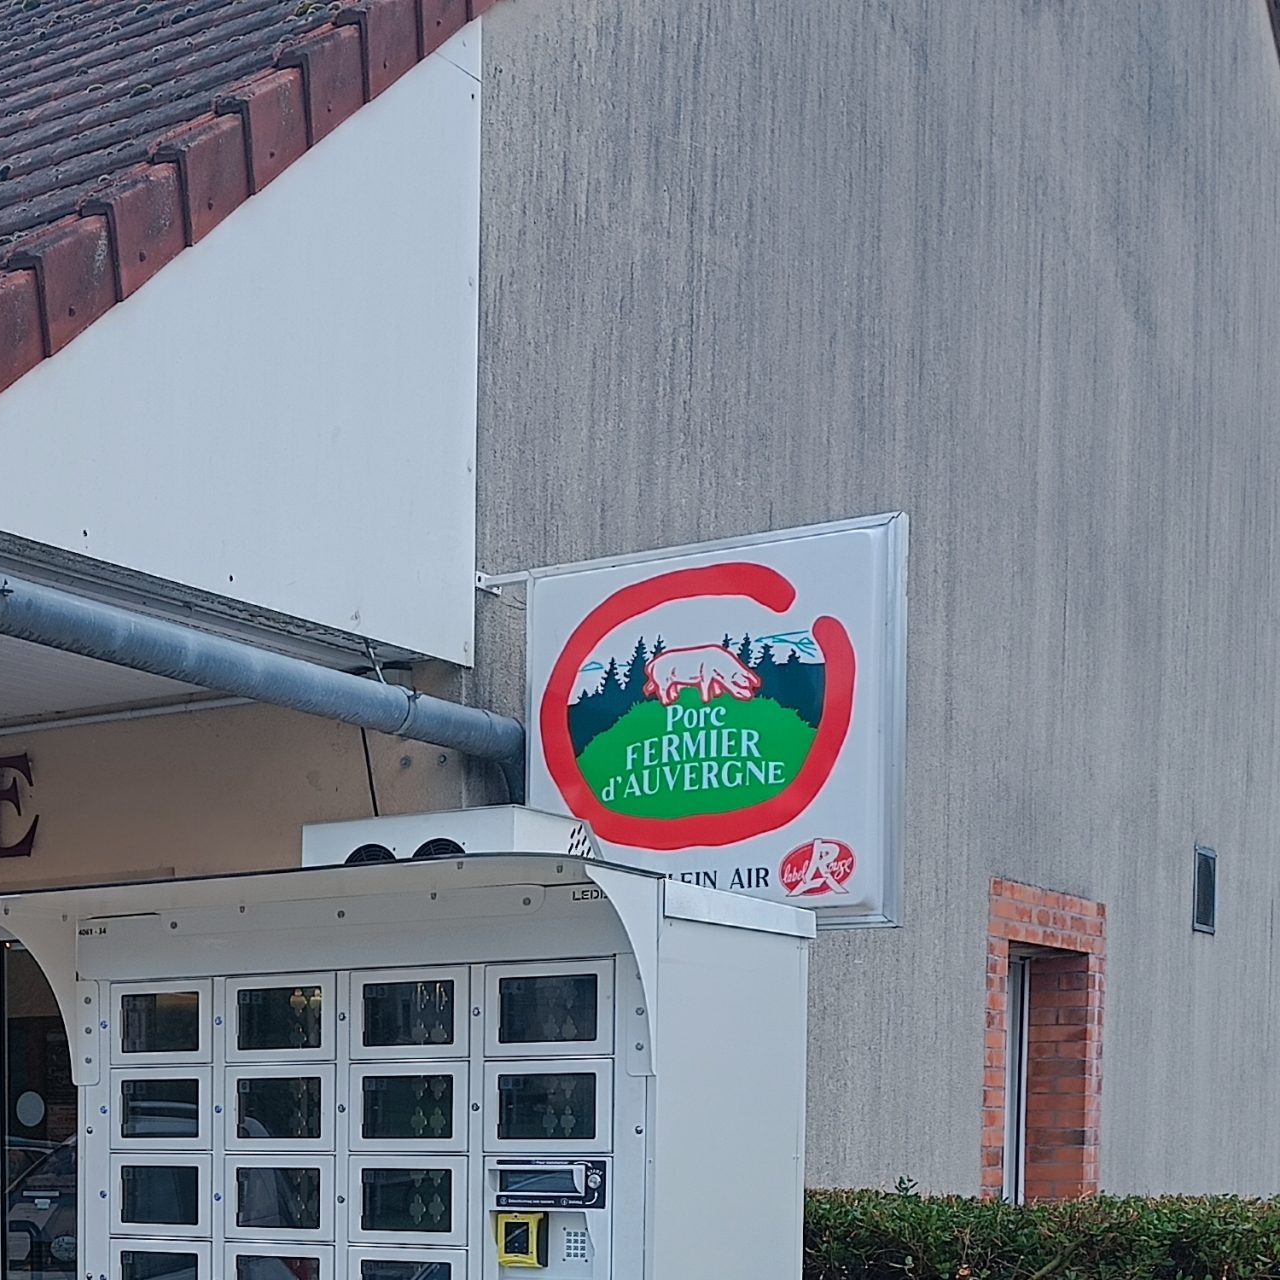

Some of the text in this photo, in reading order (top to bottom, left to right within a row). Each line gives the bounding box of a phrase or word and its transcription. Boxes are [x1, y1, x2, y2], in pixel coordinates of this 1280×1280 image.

[665, 704, 726, 732] Porc
[625, 728, 762, 771] FERMIER
[601, 761, 786, 802] d'AUVERGNE
[729, 867, 769, 889] AIR
